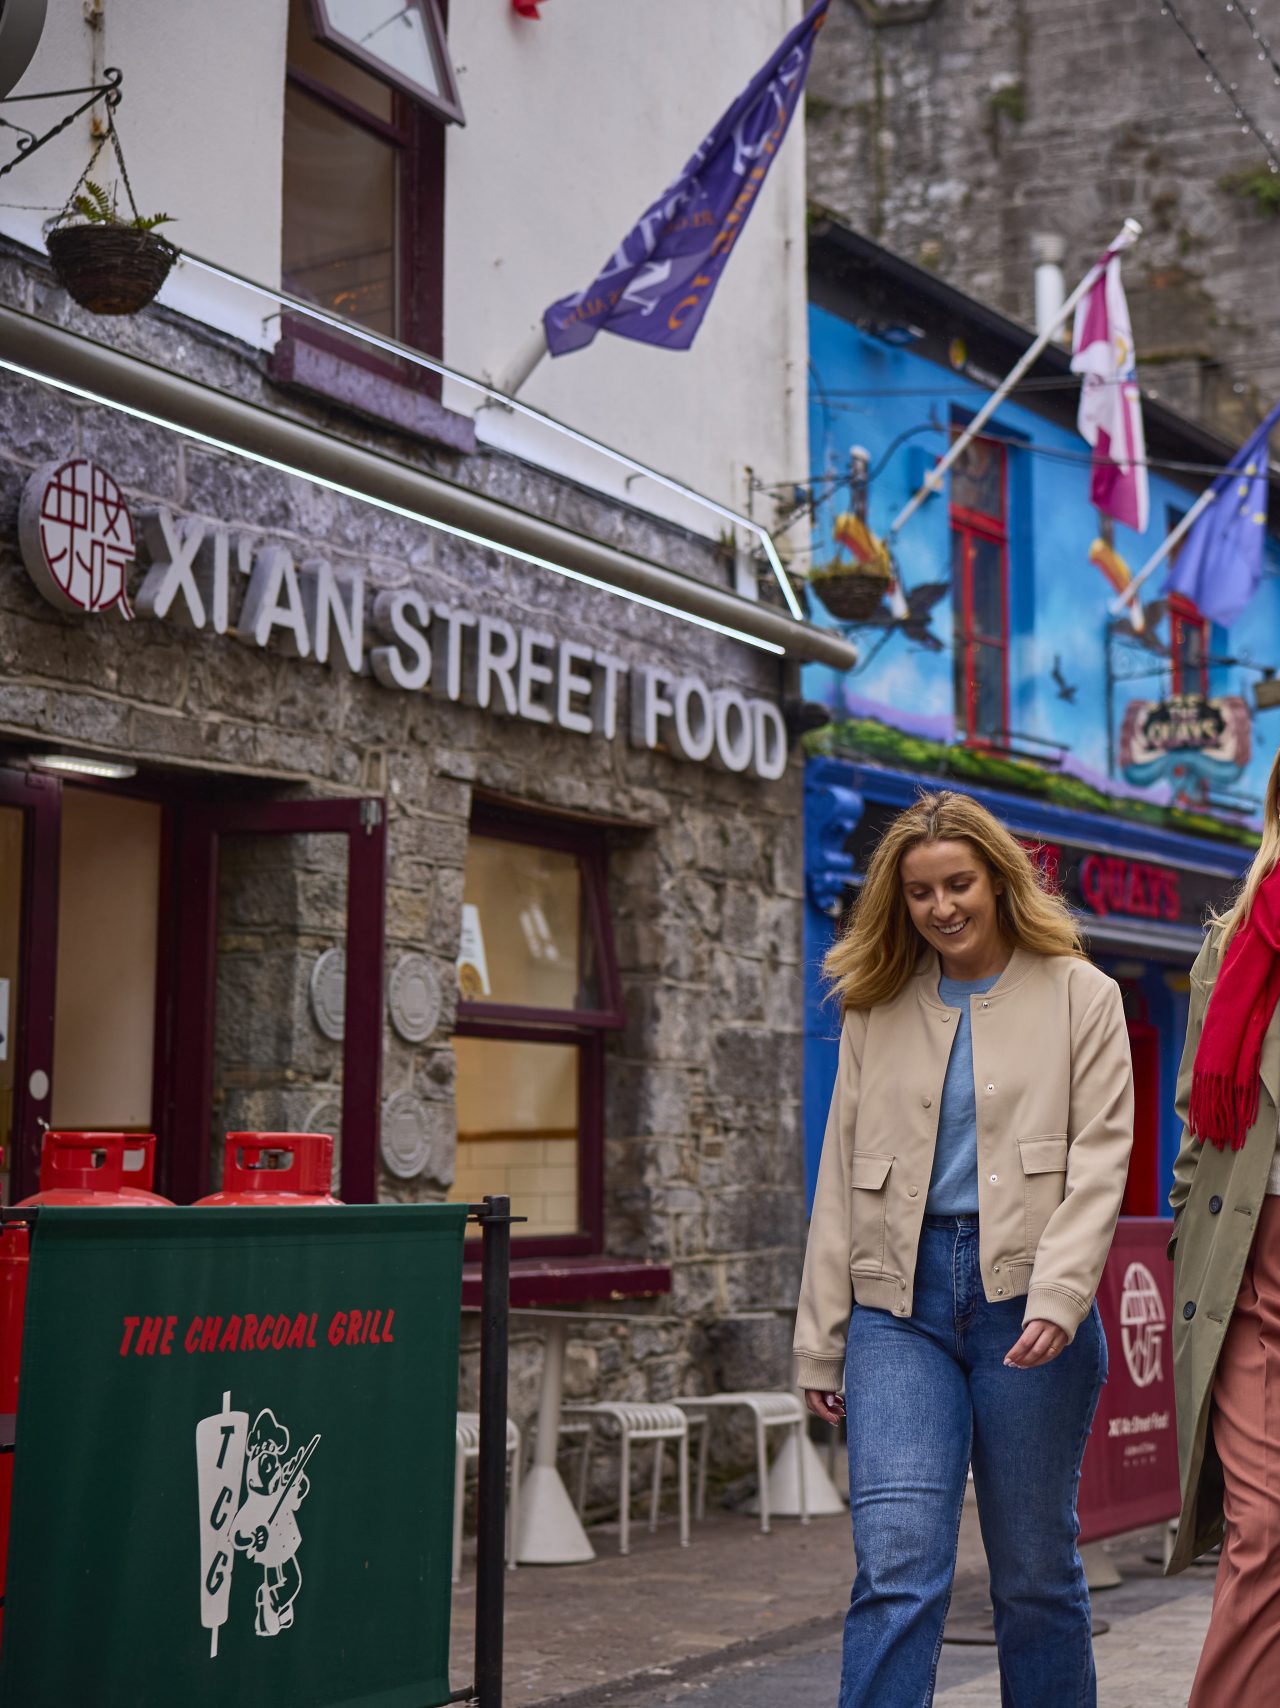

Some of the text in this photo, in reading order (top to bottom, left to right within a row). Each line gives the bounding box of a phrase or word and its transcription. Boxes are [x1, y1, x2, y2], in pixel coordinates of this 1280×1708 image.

[148, 506, 365, 674] XI'AN
[382, 588, 629, 741] STREET
[640, 666, 789, 781] FOOD
[1146, 719, 1218, 746] QUAYS
[1081, 853, 1180, 920] QUAYS
[120, 1308, 396, 1356] THE CHARCOAL GRILL
